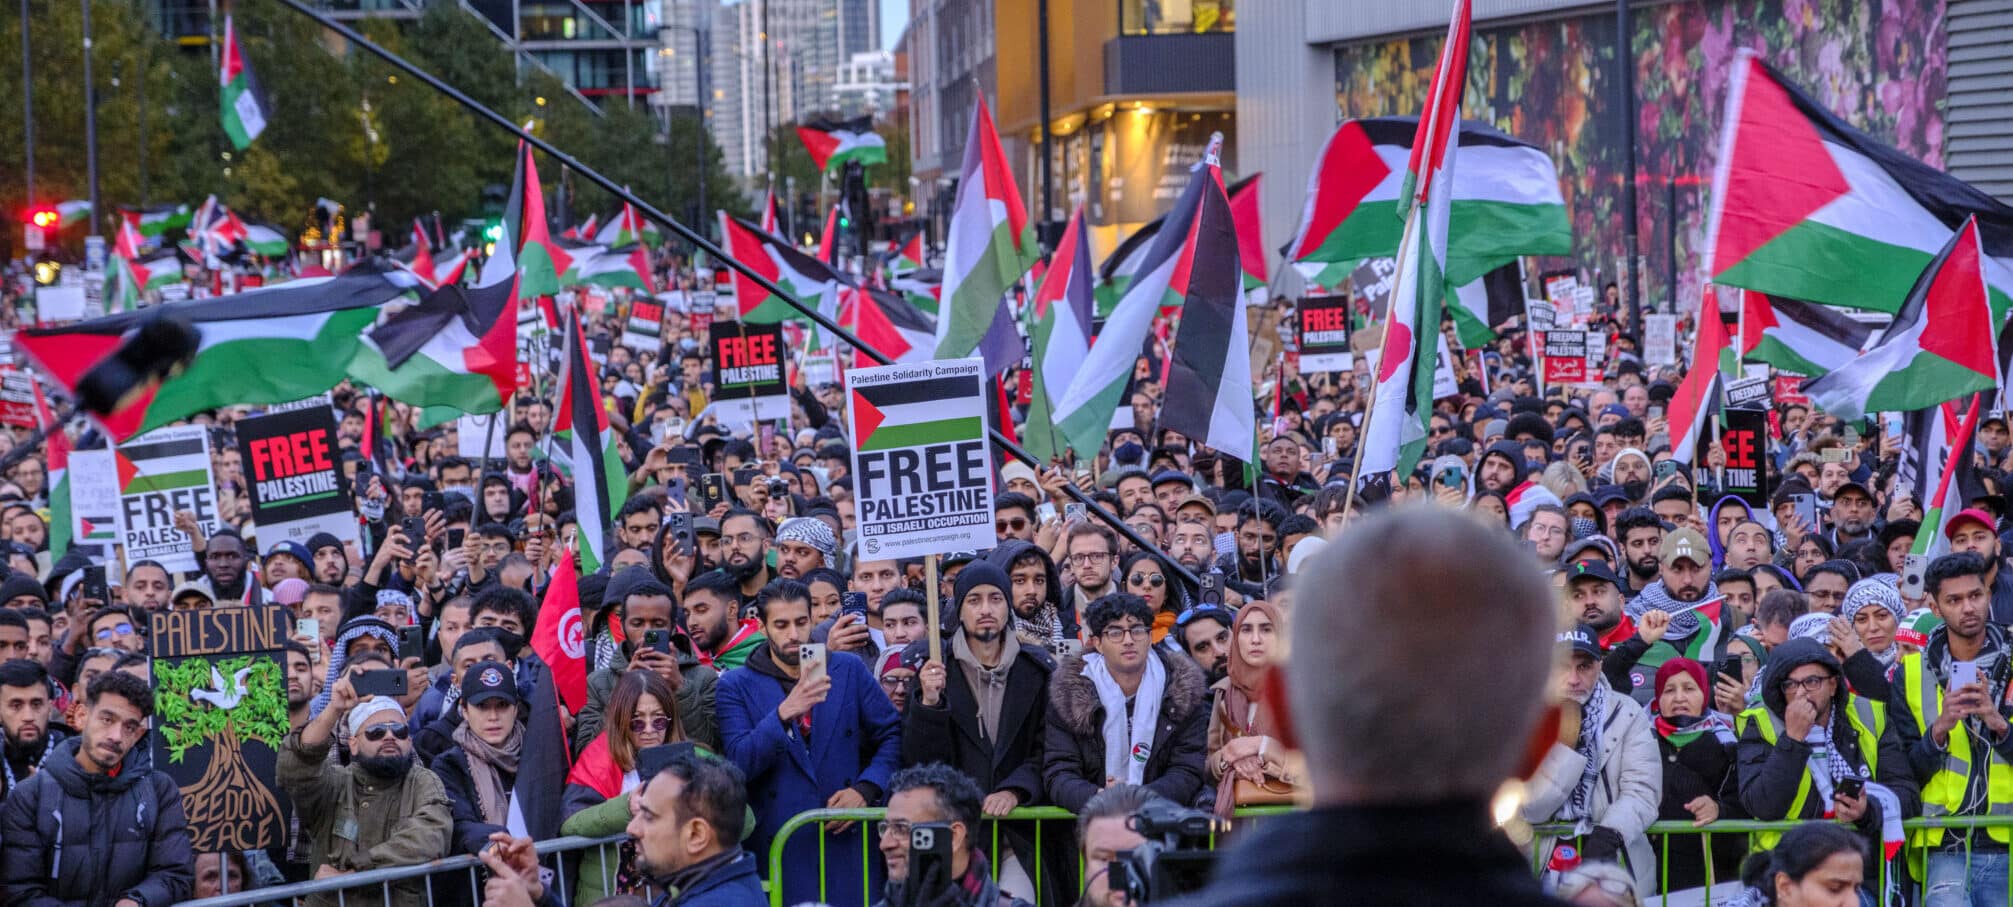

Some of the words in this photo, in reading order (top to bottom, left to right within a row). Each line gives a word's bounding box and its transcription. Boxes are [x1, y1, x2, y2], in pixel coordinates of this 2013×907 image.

[1302, 307, 1345, 333] FREE
[1547, 331, 1584, 343] FREEDOM
[718, 333, 778, 369] FREE
[1545, 344, 1586, 357] PALESTINE
[720, 364, 780, 384] PALESTINE
[851, 374, 891, 384] Palestine
[892, 368, 933, 380] Solidarity
[935, 364, 979, 375] Campaign
[1730, 382, 1767, 403] FREEDOM
[250, 428, 334, 482] FREE
[857, 441, 988, 499] FREE
[256, 469, 339, 503] PALESTINE
[121, 487, 215, 531] FREE
[860, 487, 989, 522] PALESTINE
[126, 521, 218, 548] PALESTNE
[863, 524, 885, 536] END
[886, 518, 926, 534] ISRAELI
[927, 512, 989, 530] OCCUPATION
[884, 532, 972, 547] www.palestinecampaign.org
[152, 605, 284, 658] PALESTINE
